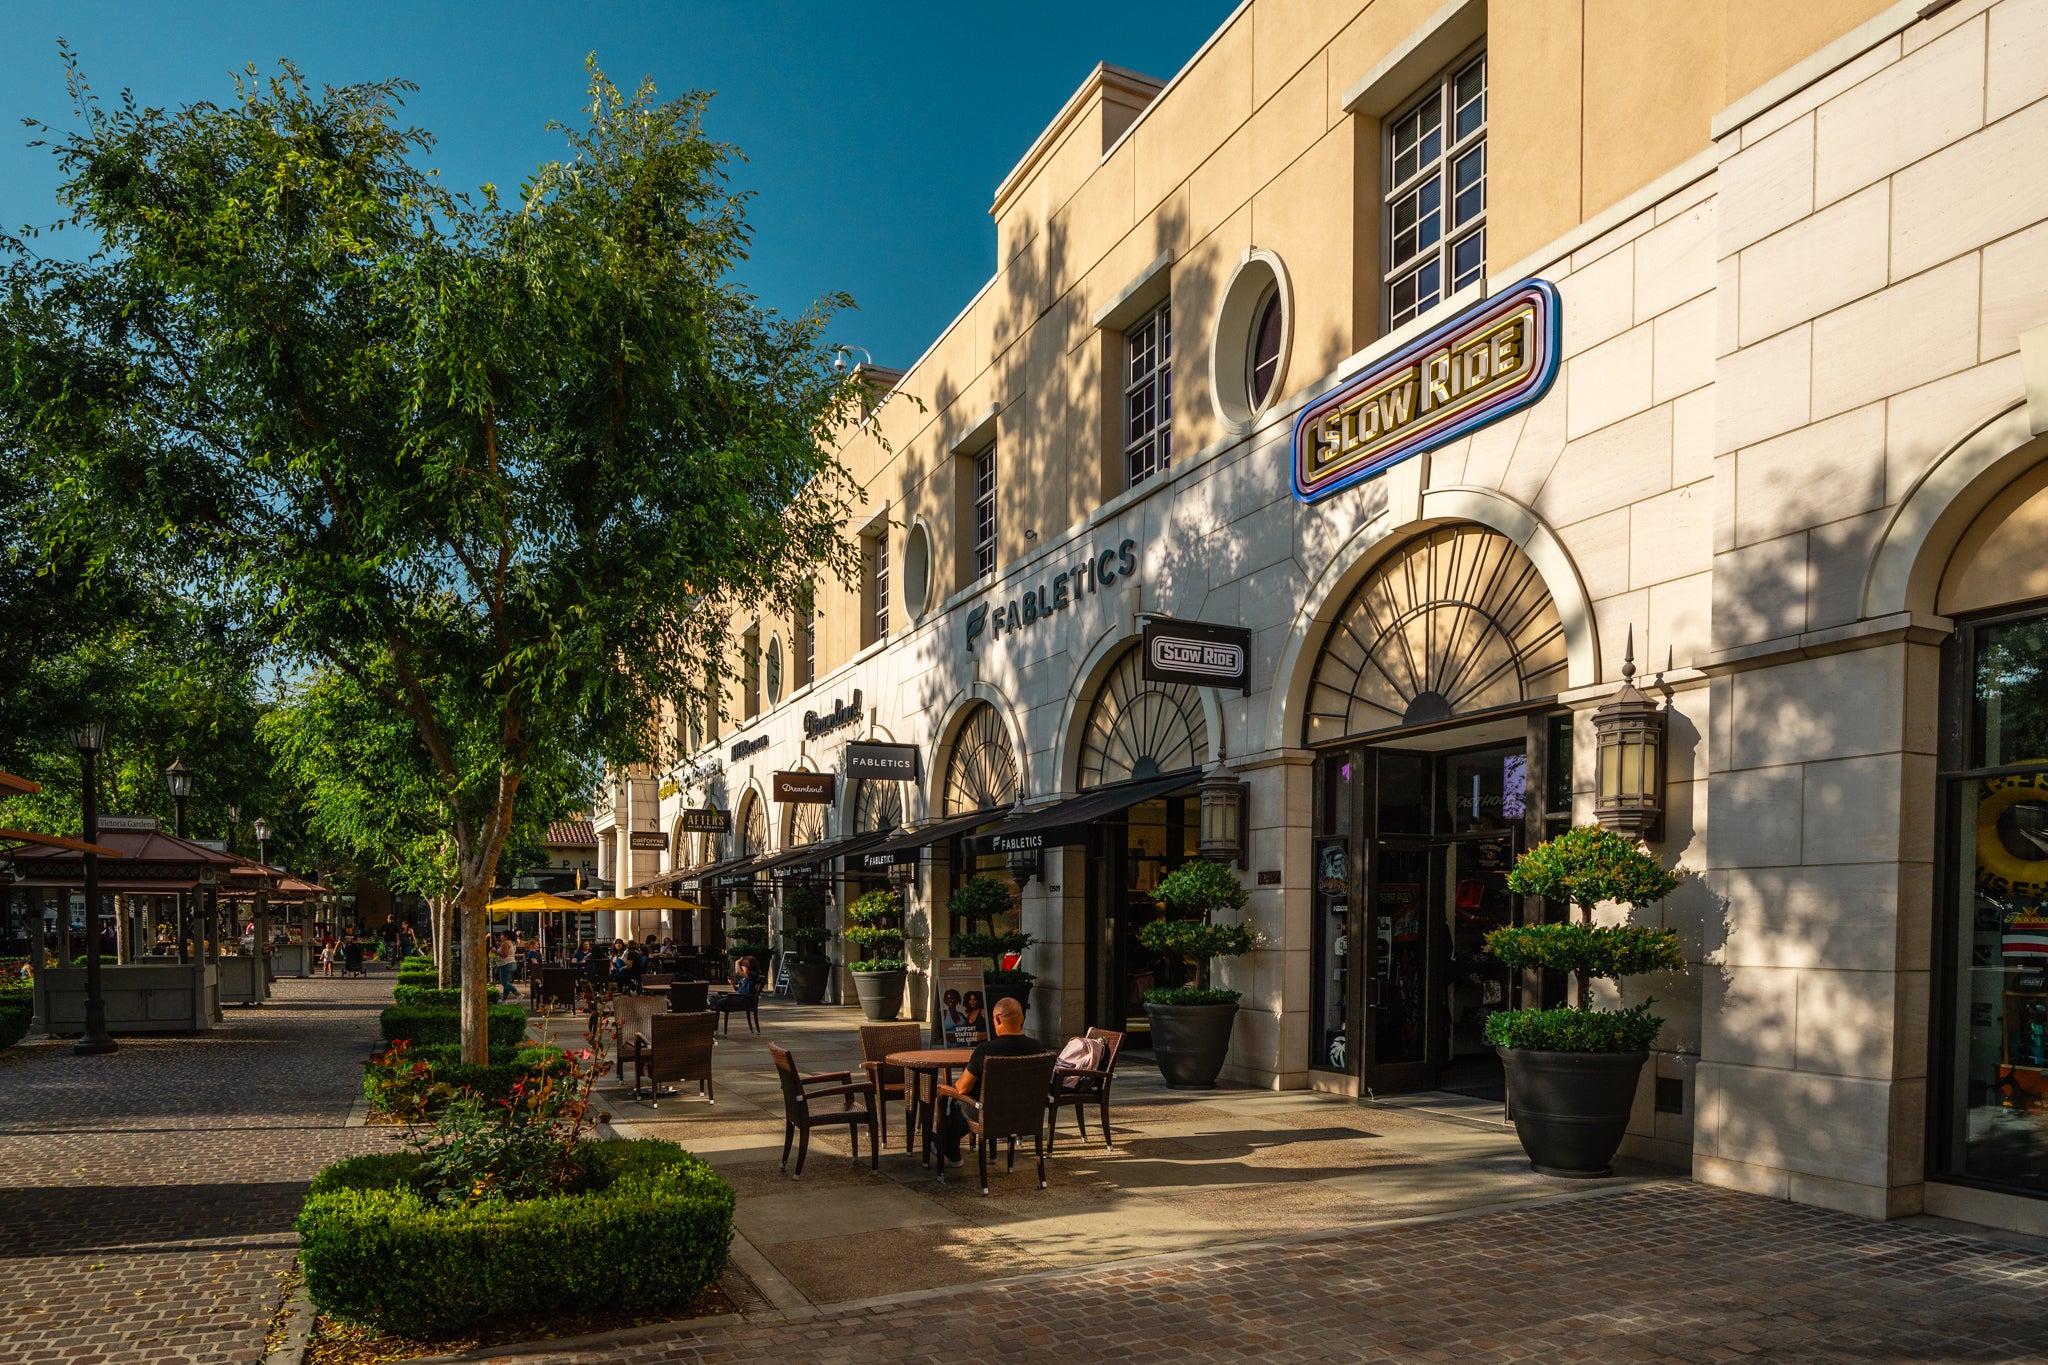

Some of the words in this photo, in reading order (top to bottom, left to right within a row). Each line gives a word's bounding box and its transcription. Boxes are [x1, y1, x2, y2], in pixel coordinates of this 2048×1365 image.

[1317, 380, 1419, 463] SLOW
[1421, 326, 1521, 413] RIDE
[992, 539, 1136, 640] FABLETICS
[1164, 643, 1202, 663] SLOW
[1203, 646, 1234, 667] RIDE
[852, 757, 911, 768] FABLETICS
[781, 783, 824, 794] Dreamland
[100, 819, 126, 827] Victoria
[127, 820, 156, 828] Gardens
[688, 815, 725, 826] AFTERS
[1001, 835, 1043, 850] FABLETICS
[869, 854, 895, 866] FABLETICS
